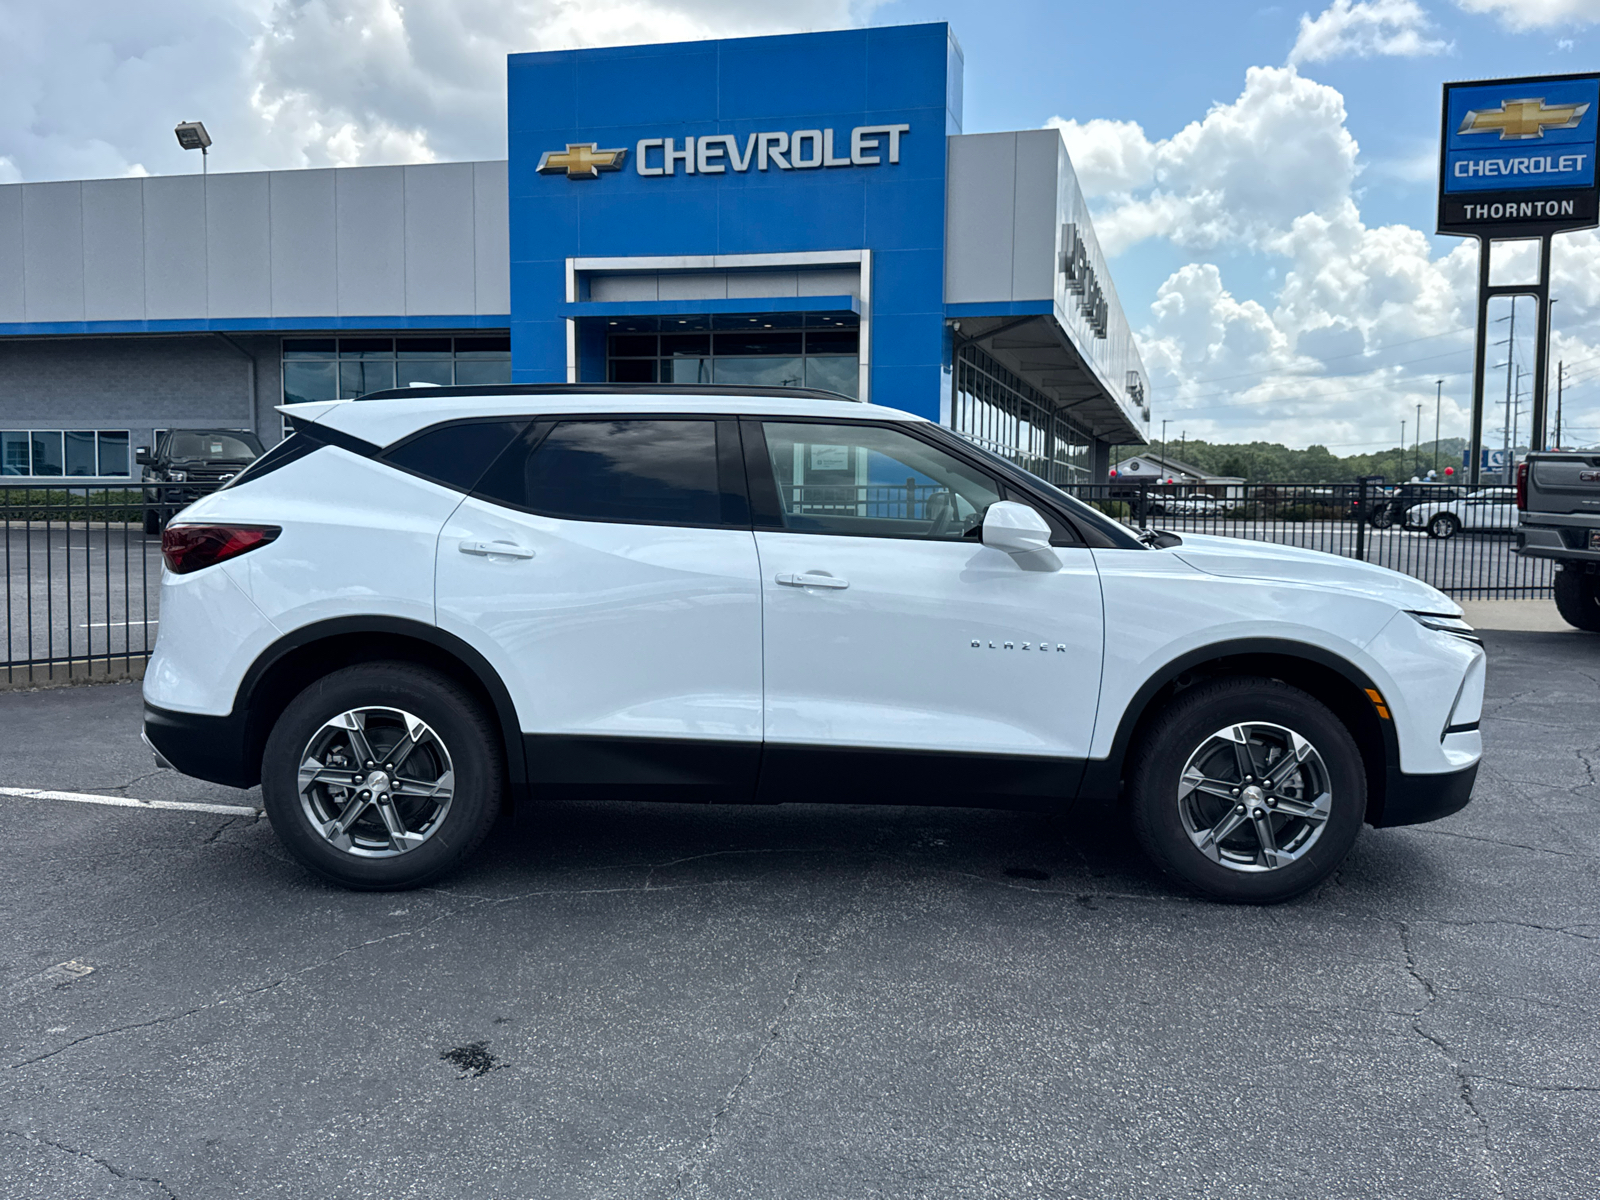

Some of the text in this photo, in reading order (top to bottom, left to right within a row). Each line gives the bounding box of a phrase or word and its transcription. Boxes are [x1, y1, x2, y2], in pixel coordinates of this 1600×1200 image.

[636, 124, 909, 176] CHEVROLET
[1454, 154, 1587, 177] CHEVROLET
[1463, 200, 1574, 220] THORNTON
[970, 639, 1067, 653] BLAZER
